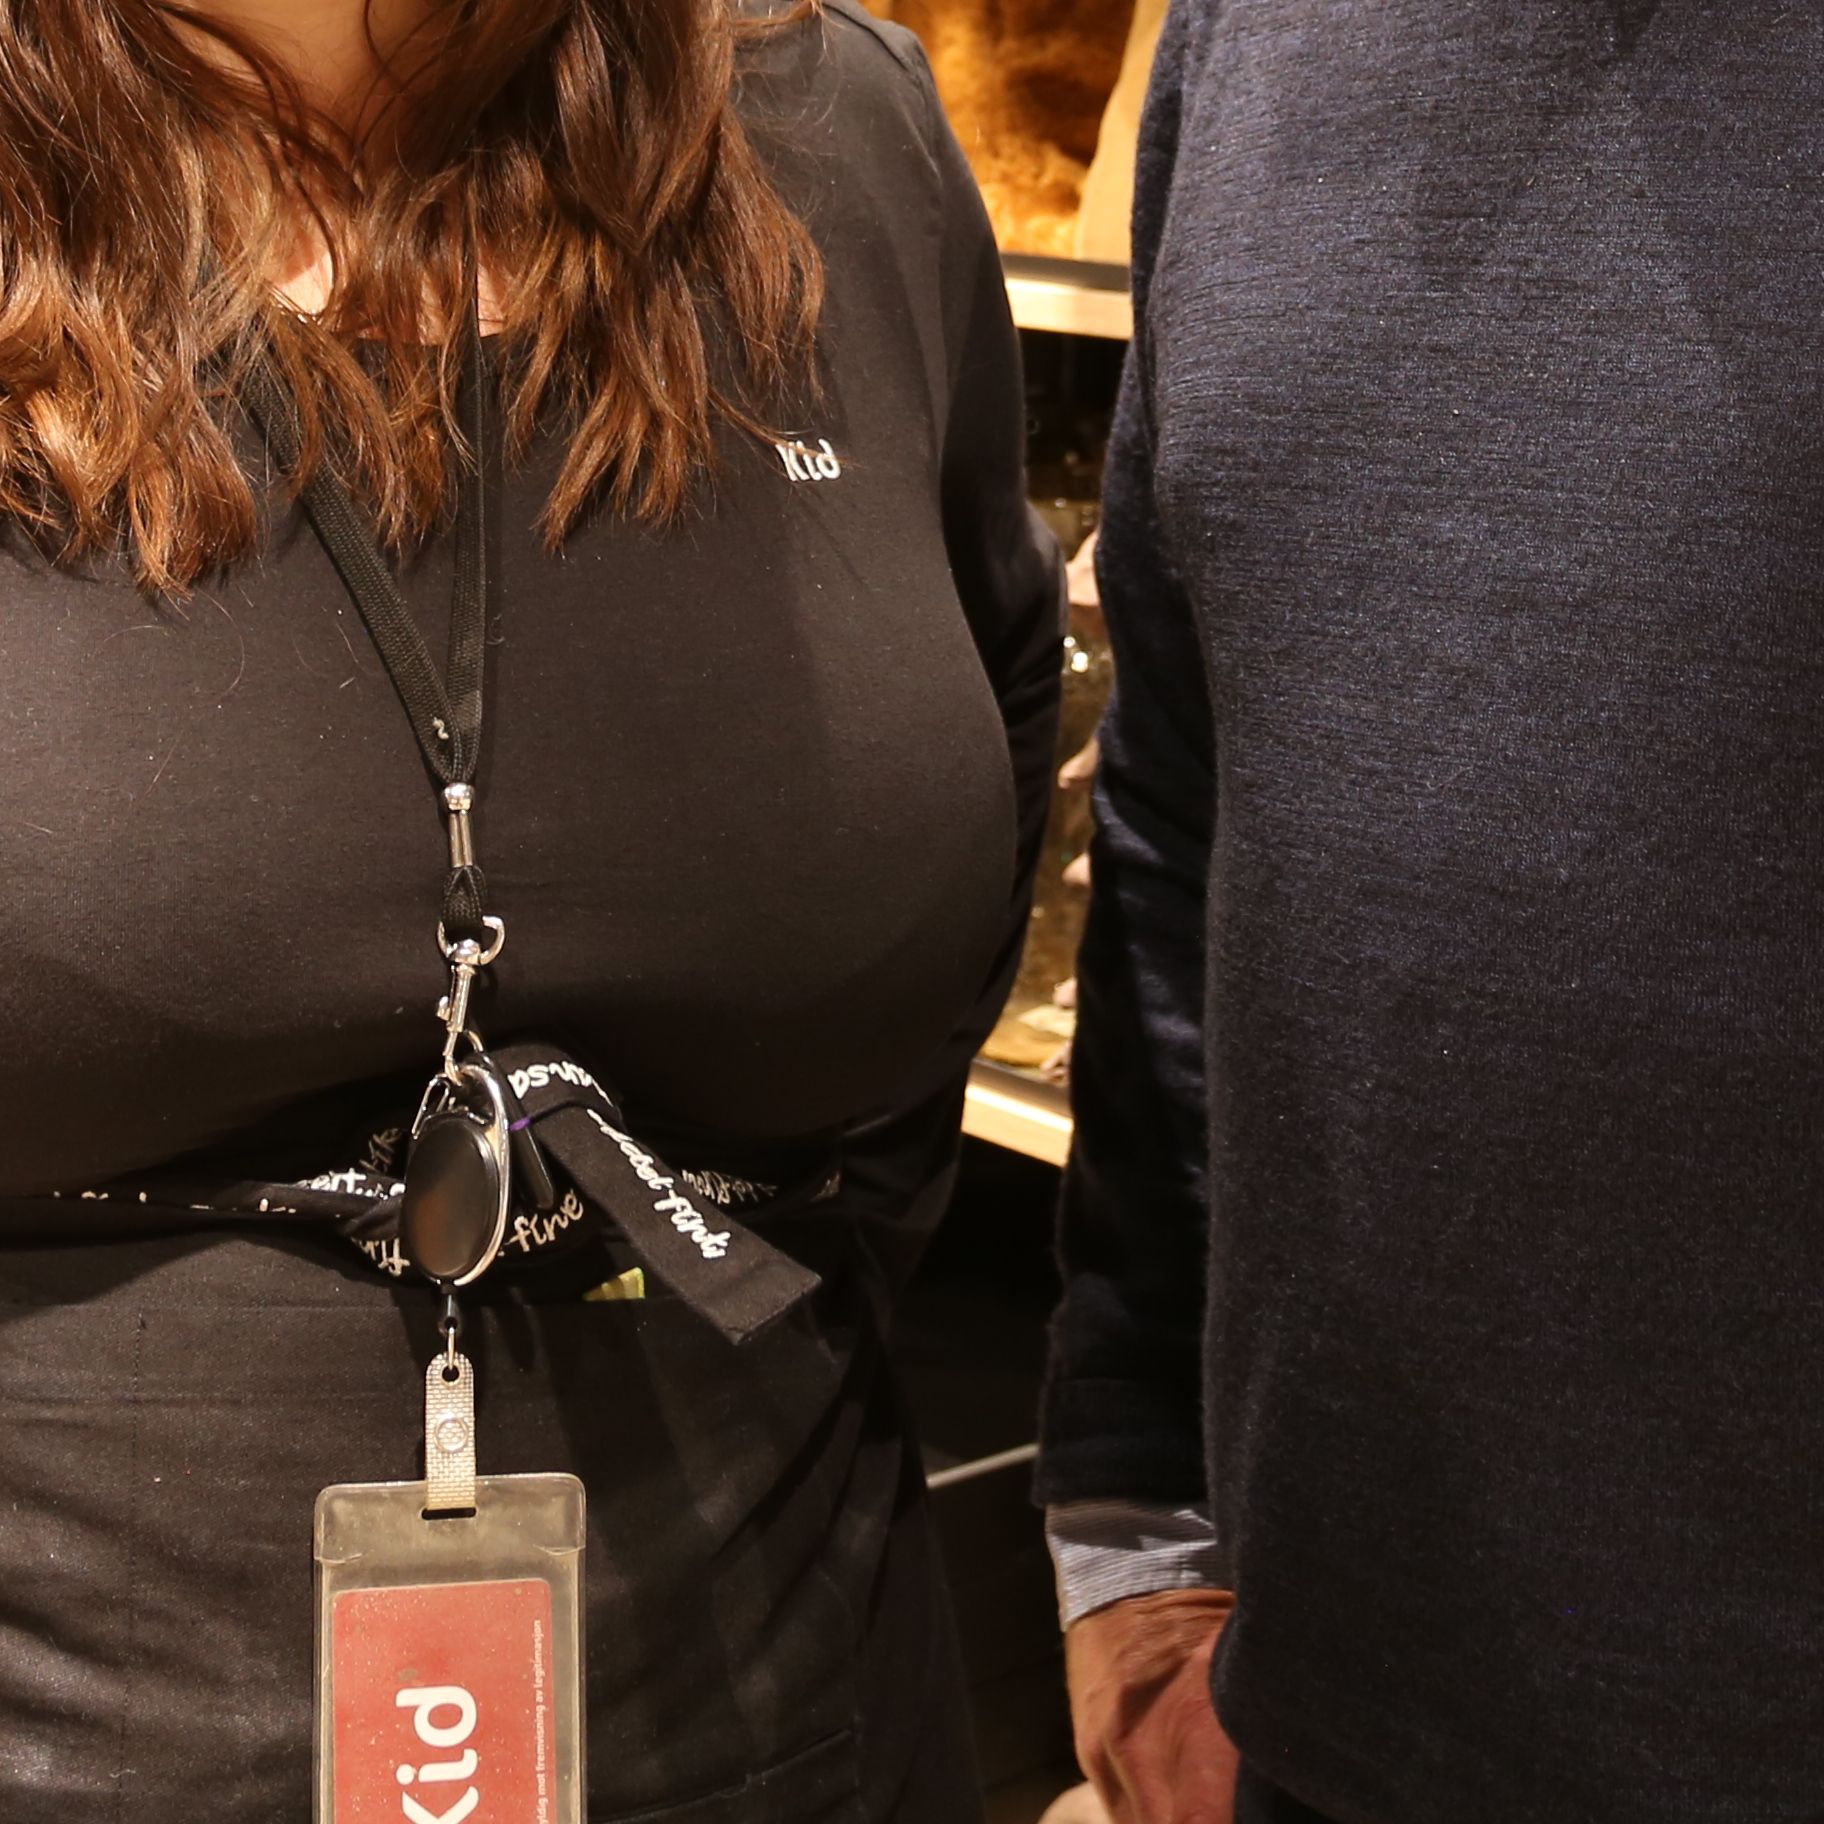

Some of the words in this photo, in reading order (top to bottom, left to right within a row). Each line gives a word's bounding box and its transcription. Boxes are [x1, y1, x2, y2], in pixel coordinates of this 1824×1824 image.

[775, 437, 842, 482] Kid
[532, 1619, 546, 1688] legitimasjon
[534, 1690, 545, 1703] av
[395, 1685, 480, 1824] Kid
[533, 1705, 547, 1771] fremvisning
[535, 1773, 547, 1796] mot
[534, 1797, 549, 1824] yldig
